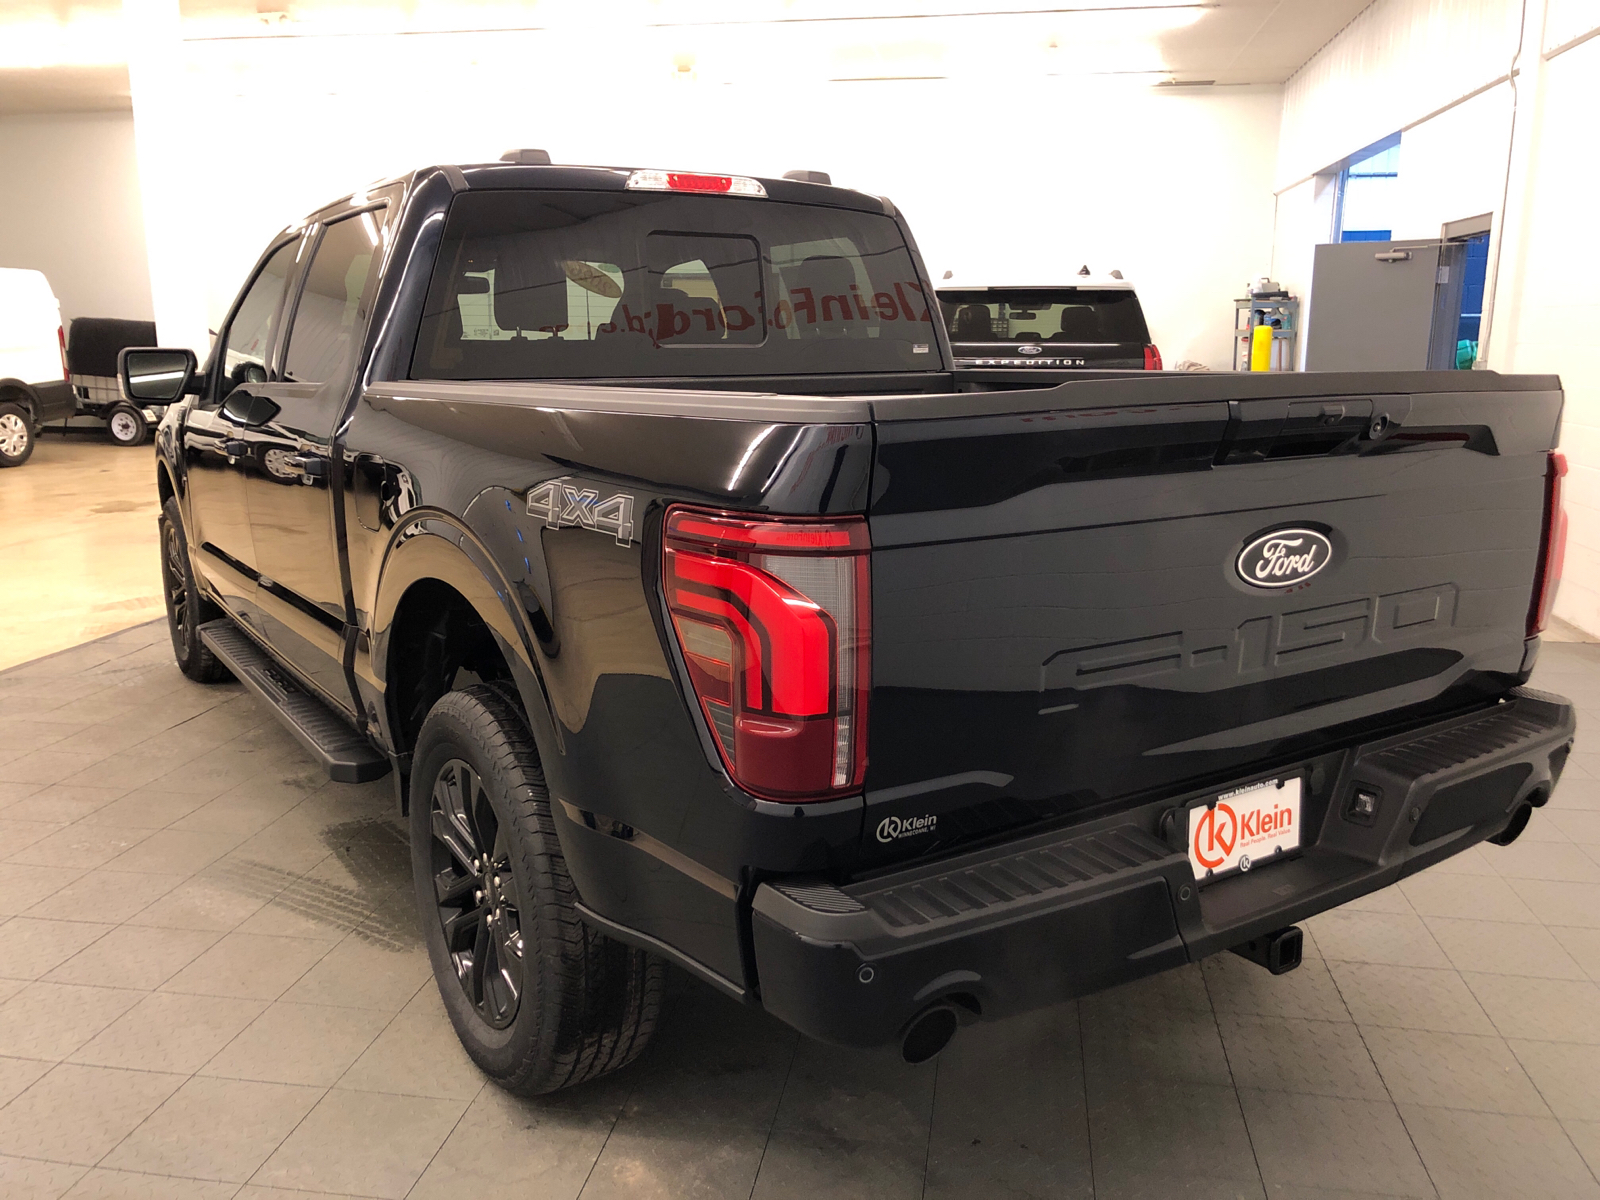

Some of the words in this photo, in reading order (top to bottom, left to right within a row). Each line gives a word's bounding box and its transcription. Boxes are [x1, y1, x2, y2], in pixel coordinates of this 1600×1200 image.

[1253, 536, 1319, 580] Ford
[1038, 582, 1460, 714] F-150
[1217, 778, 1279, 801] www.kleinauto.com
[902, 814, 938, 832] Klein
[1240, 803, 1292, 841] Klein
[1239, 840, 1250, 848] Real
[1267, 831, 1278, 839] Real
